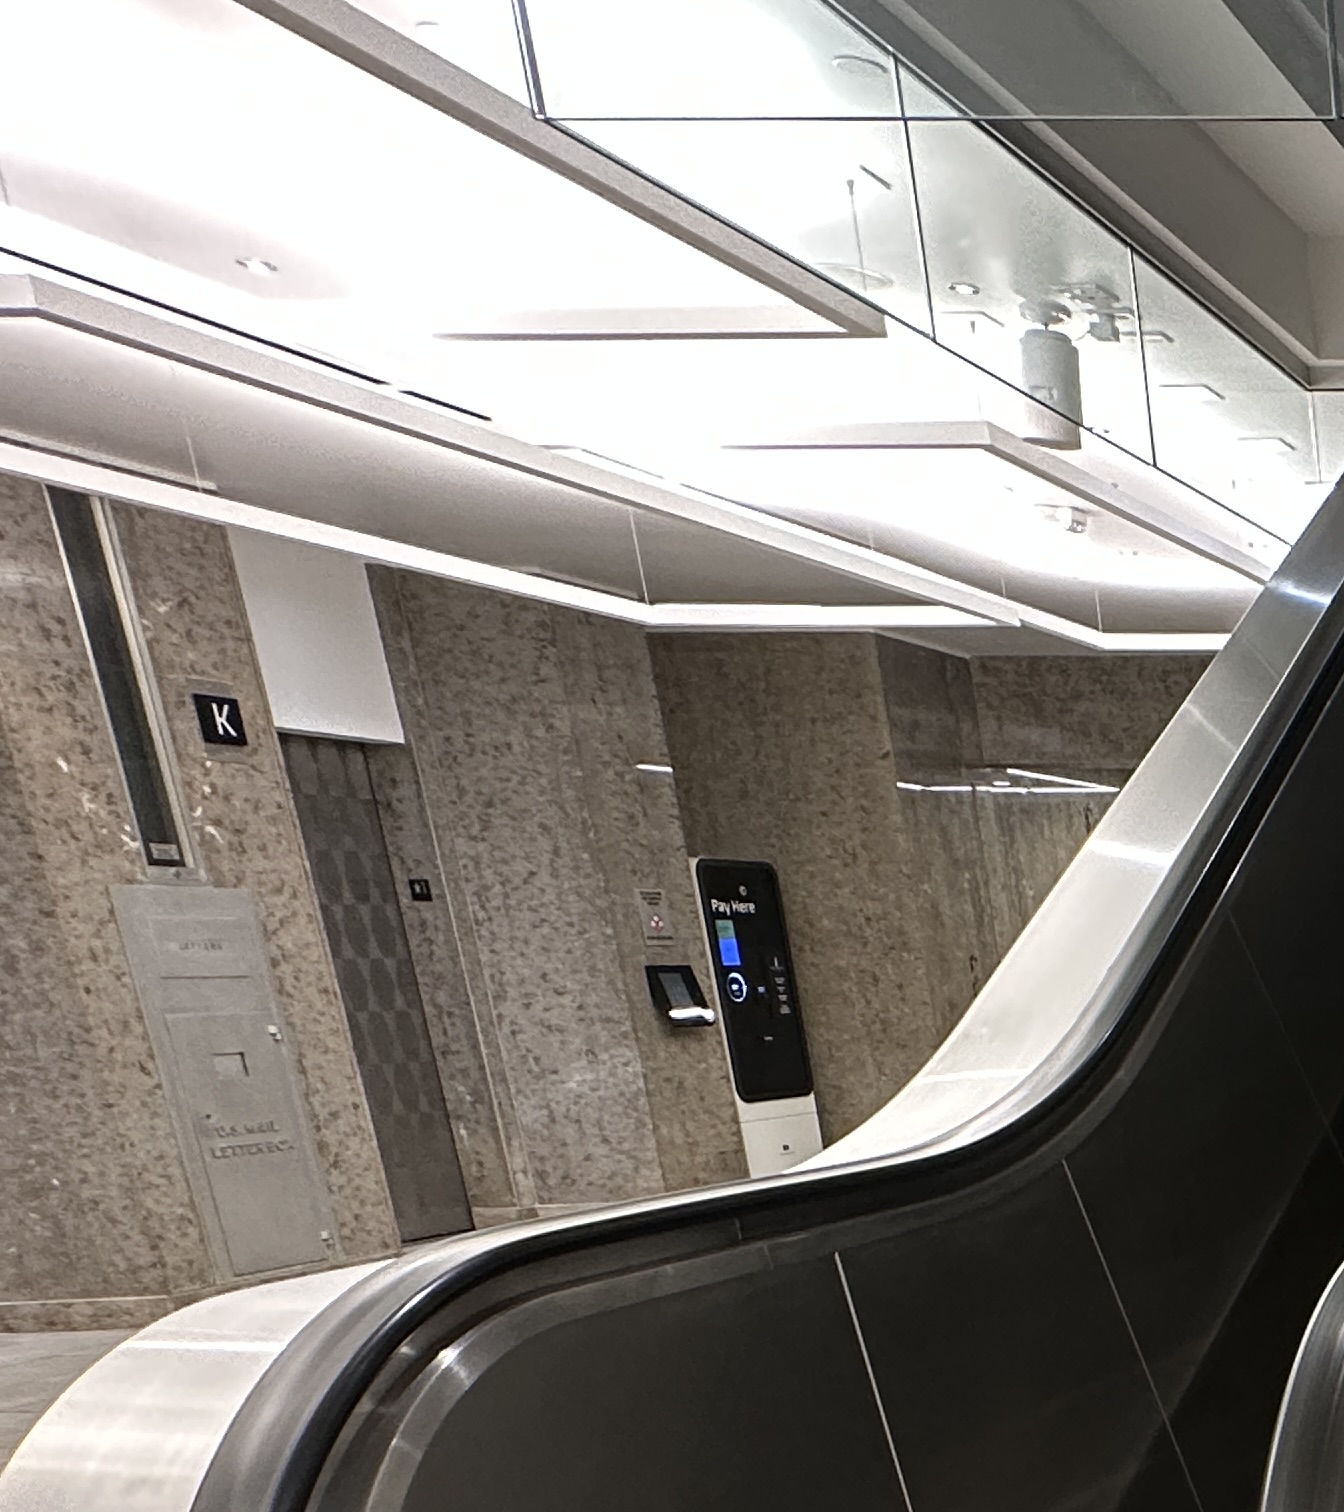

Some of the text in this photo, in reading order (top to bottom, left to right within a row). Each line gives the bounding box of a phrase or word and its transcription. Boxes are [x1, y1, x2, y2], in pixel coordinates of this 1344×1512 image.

[211, 702, 238, 738] K
[711, 899, 756, 915] Pay Here
